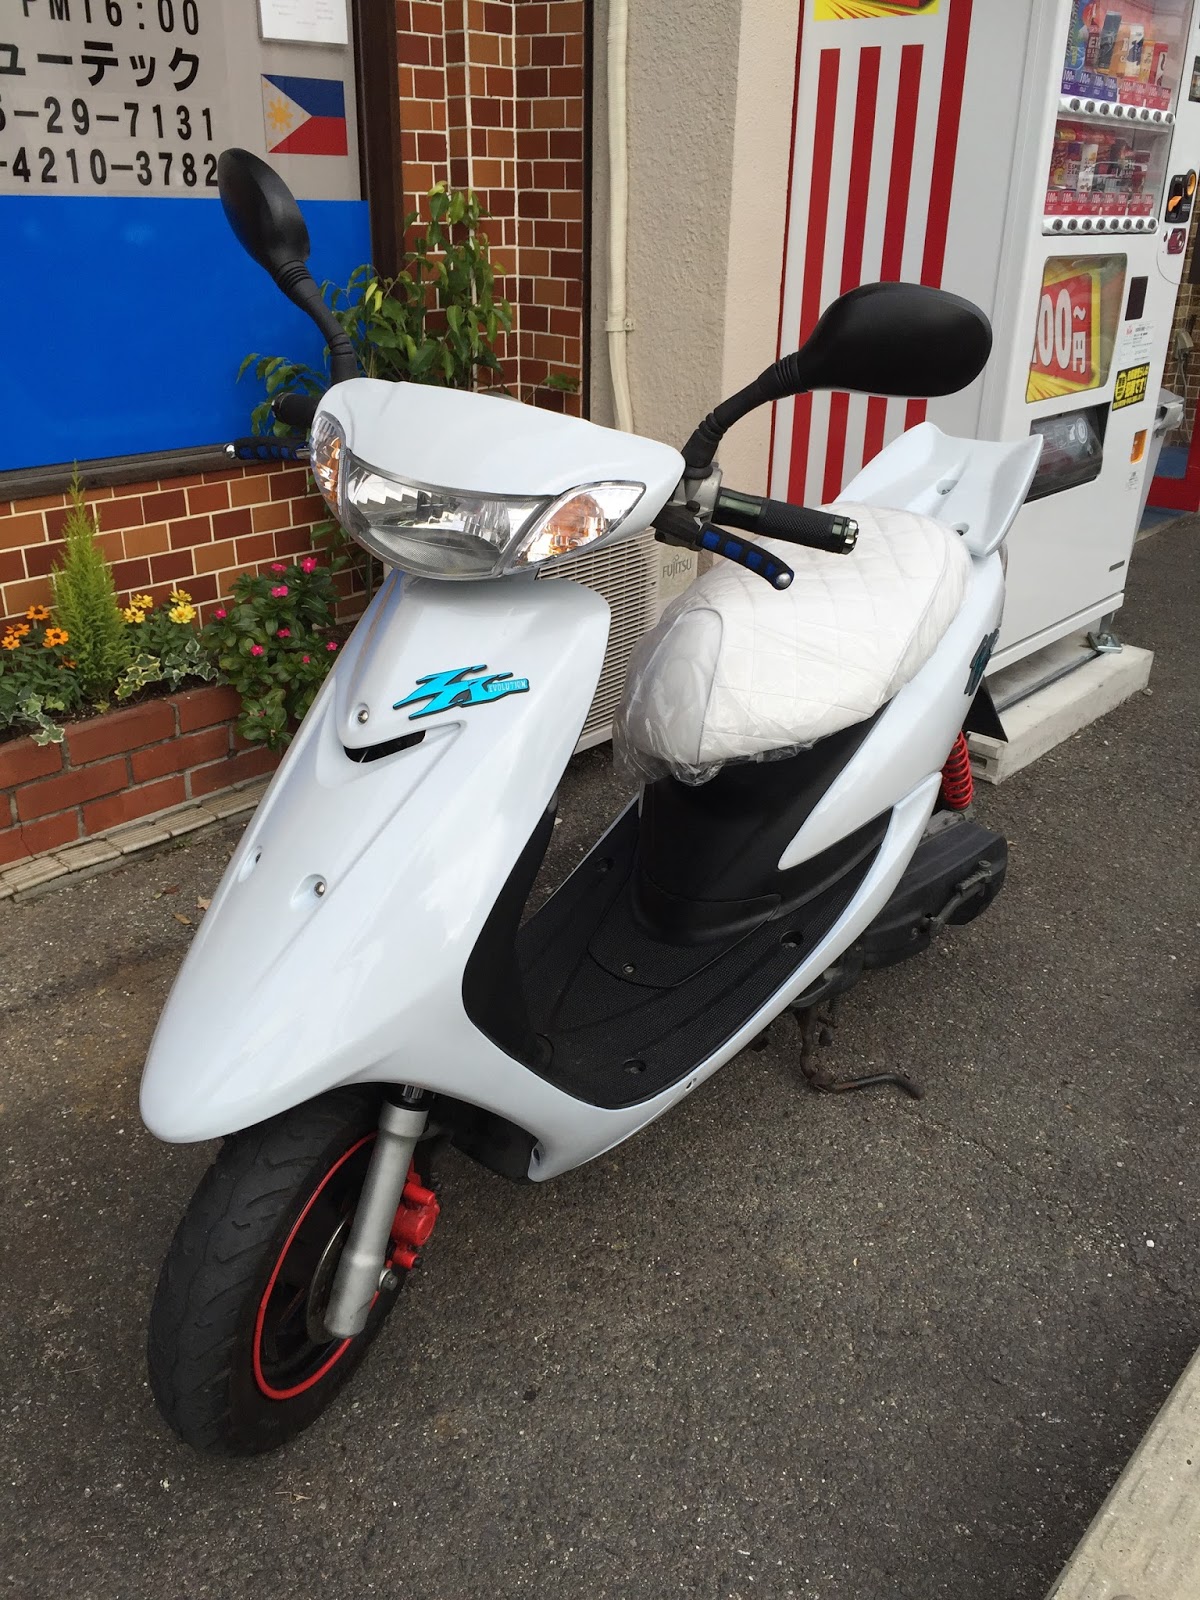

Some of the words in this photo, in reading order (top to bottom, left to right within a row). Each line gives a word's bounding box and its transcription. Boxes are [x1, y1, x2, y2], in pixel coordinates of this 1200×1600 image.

[0, 94, 213, 141] -29-7131
[662, 554, 692, 578] FUJITSU
[487, 679, 528, 693] EVOLUTION
